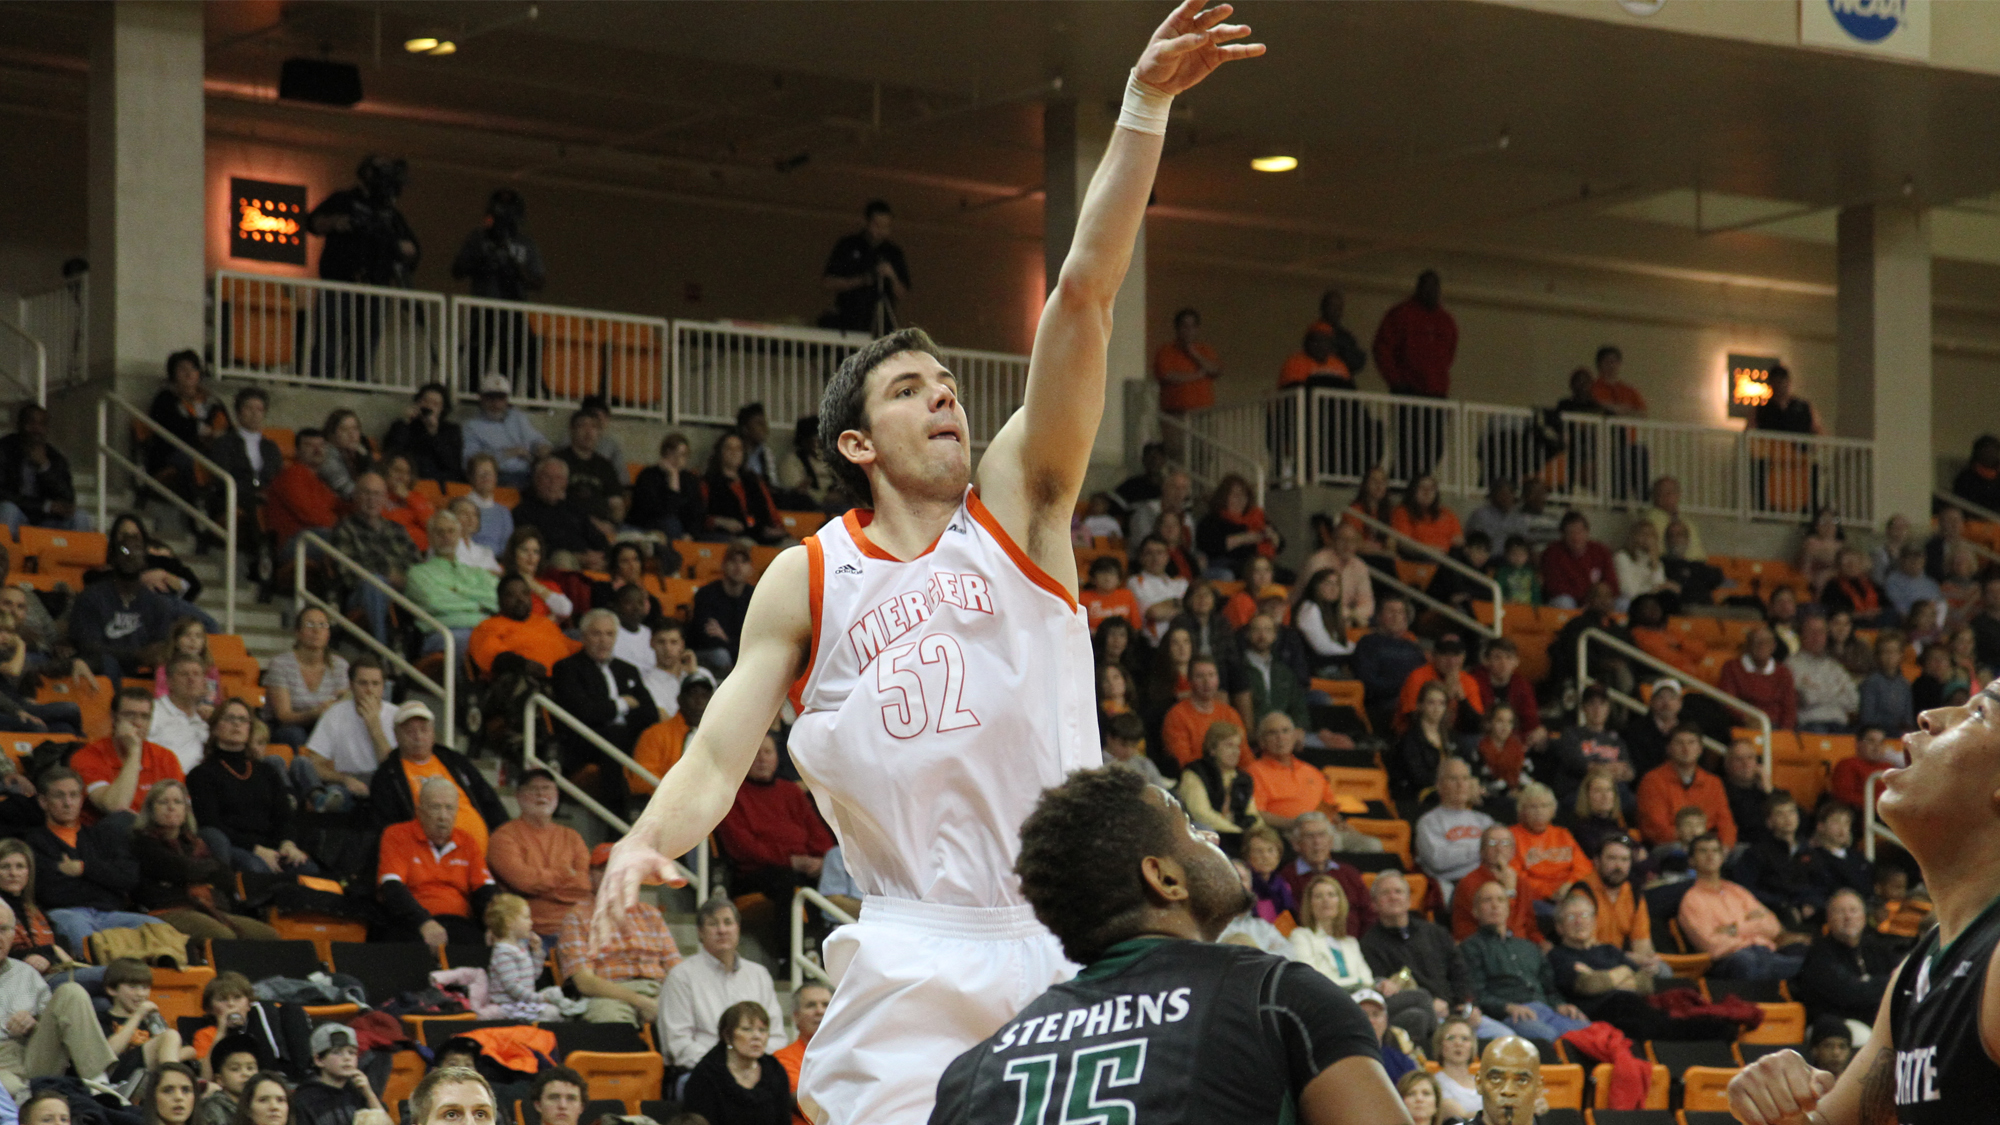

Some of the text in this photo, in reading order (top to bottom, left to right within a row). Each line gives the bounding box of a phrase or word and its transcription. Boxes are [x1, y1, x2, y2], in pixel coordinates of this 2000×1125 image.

[848, 572, 994, 676] MERCER
[877, 633, 981, 739] 52
[993, 987, 1191, 1053] STEPHENS
[1003, 1037, 1148, 1125] 15
